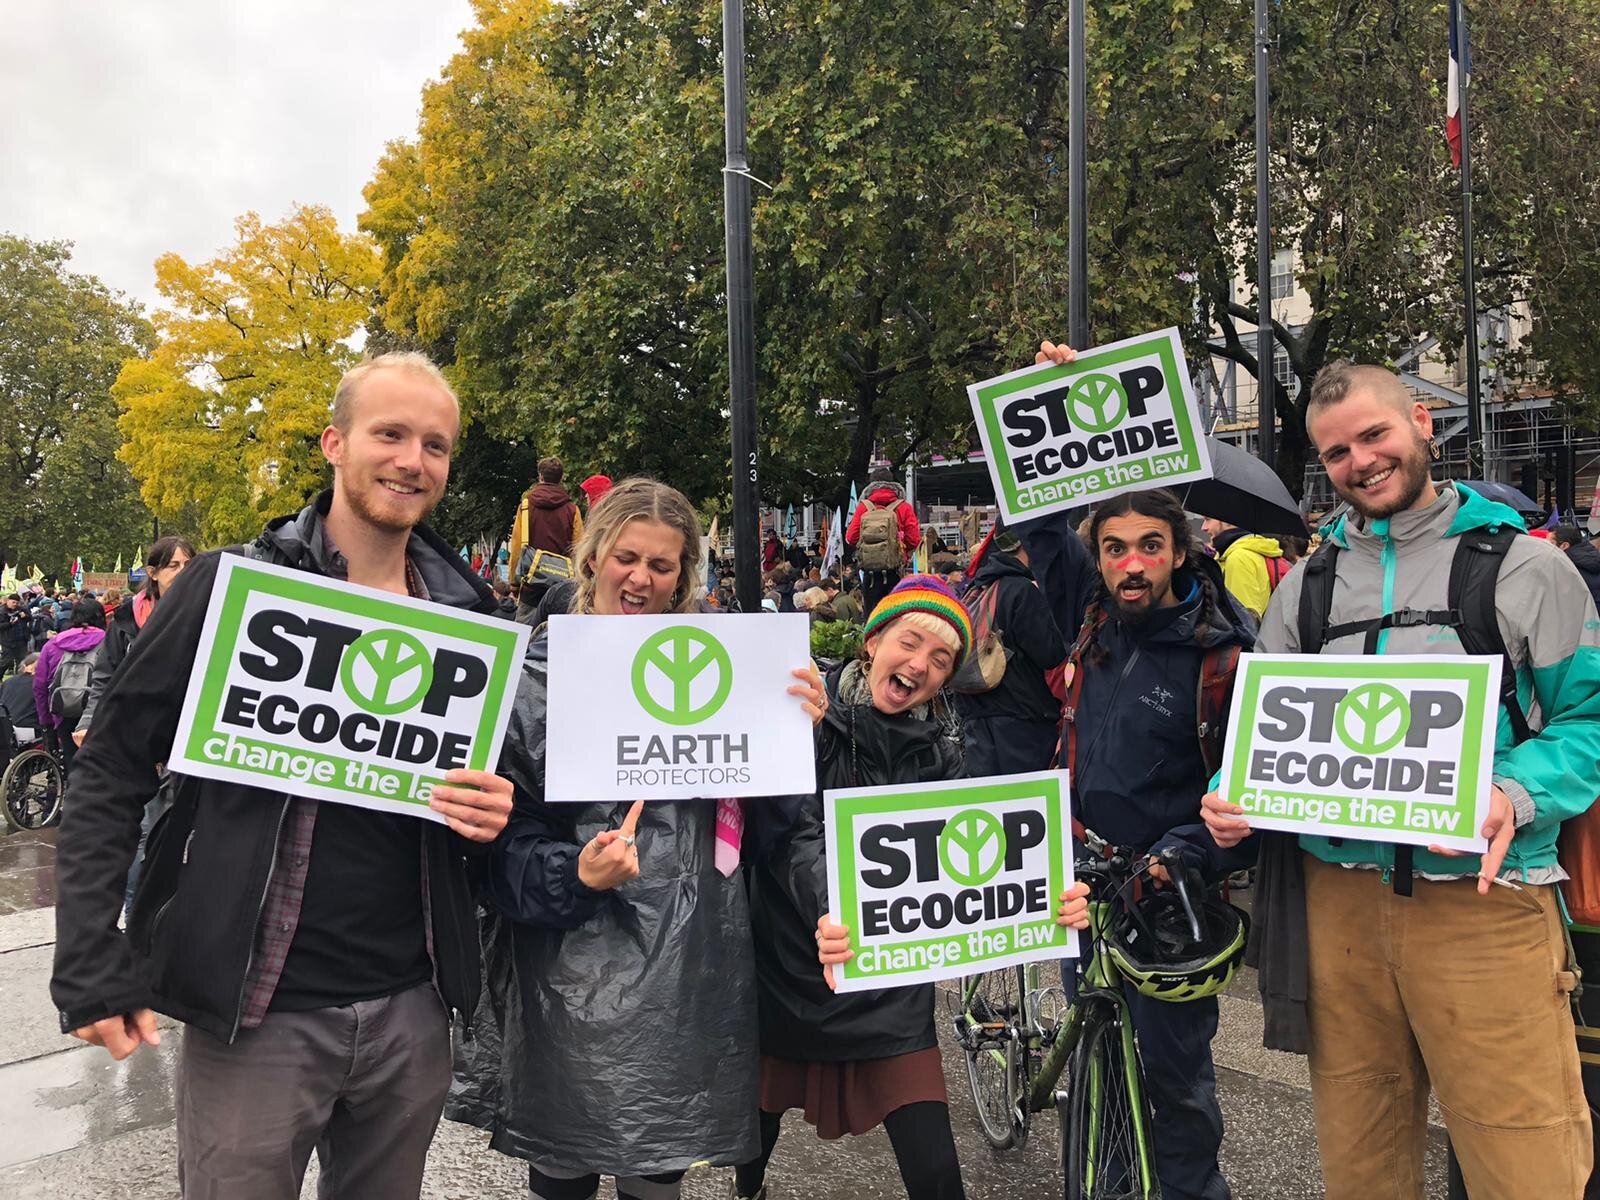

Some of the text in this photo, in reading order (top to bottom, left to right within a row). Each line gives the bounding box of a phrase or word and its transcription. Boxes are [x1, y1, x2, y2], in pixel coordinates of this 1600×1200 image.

[1002, 365, 1164, 448] STOP
[1012, 418, 1179, 483] ECOCIDE
[1016, 453, 1189, 508] change the law
[239, 609, 488, 718] STOP
[221, 685, 472, 770] ECOCIDE
[616, 733, 749, 766] EARTH
[1258, 683, 1463, 755] STOP
[203, 735, 437, 802] change the la
[616, 767, 750, 786] PROTECTORS
[1249, 749, 1456, 796] ECOCIDE
[1239, 788, 1461, 832] change the law
[860, 809, 1046, 889] STOP
[861, 877, 1048, 937] ECOCIDE
[856, 923, 1056, 973] change the law
